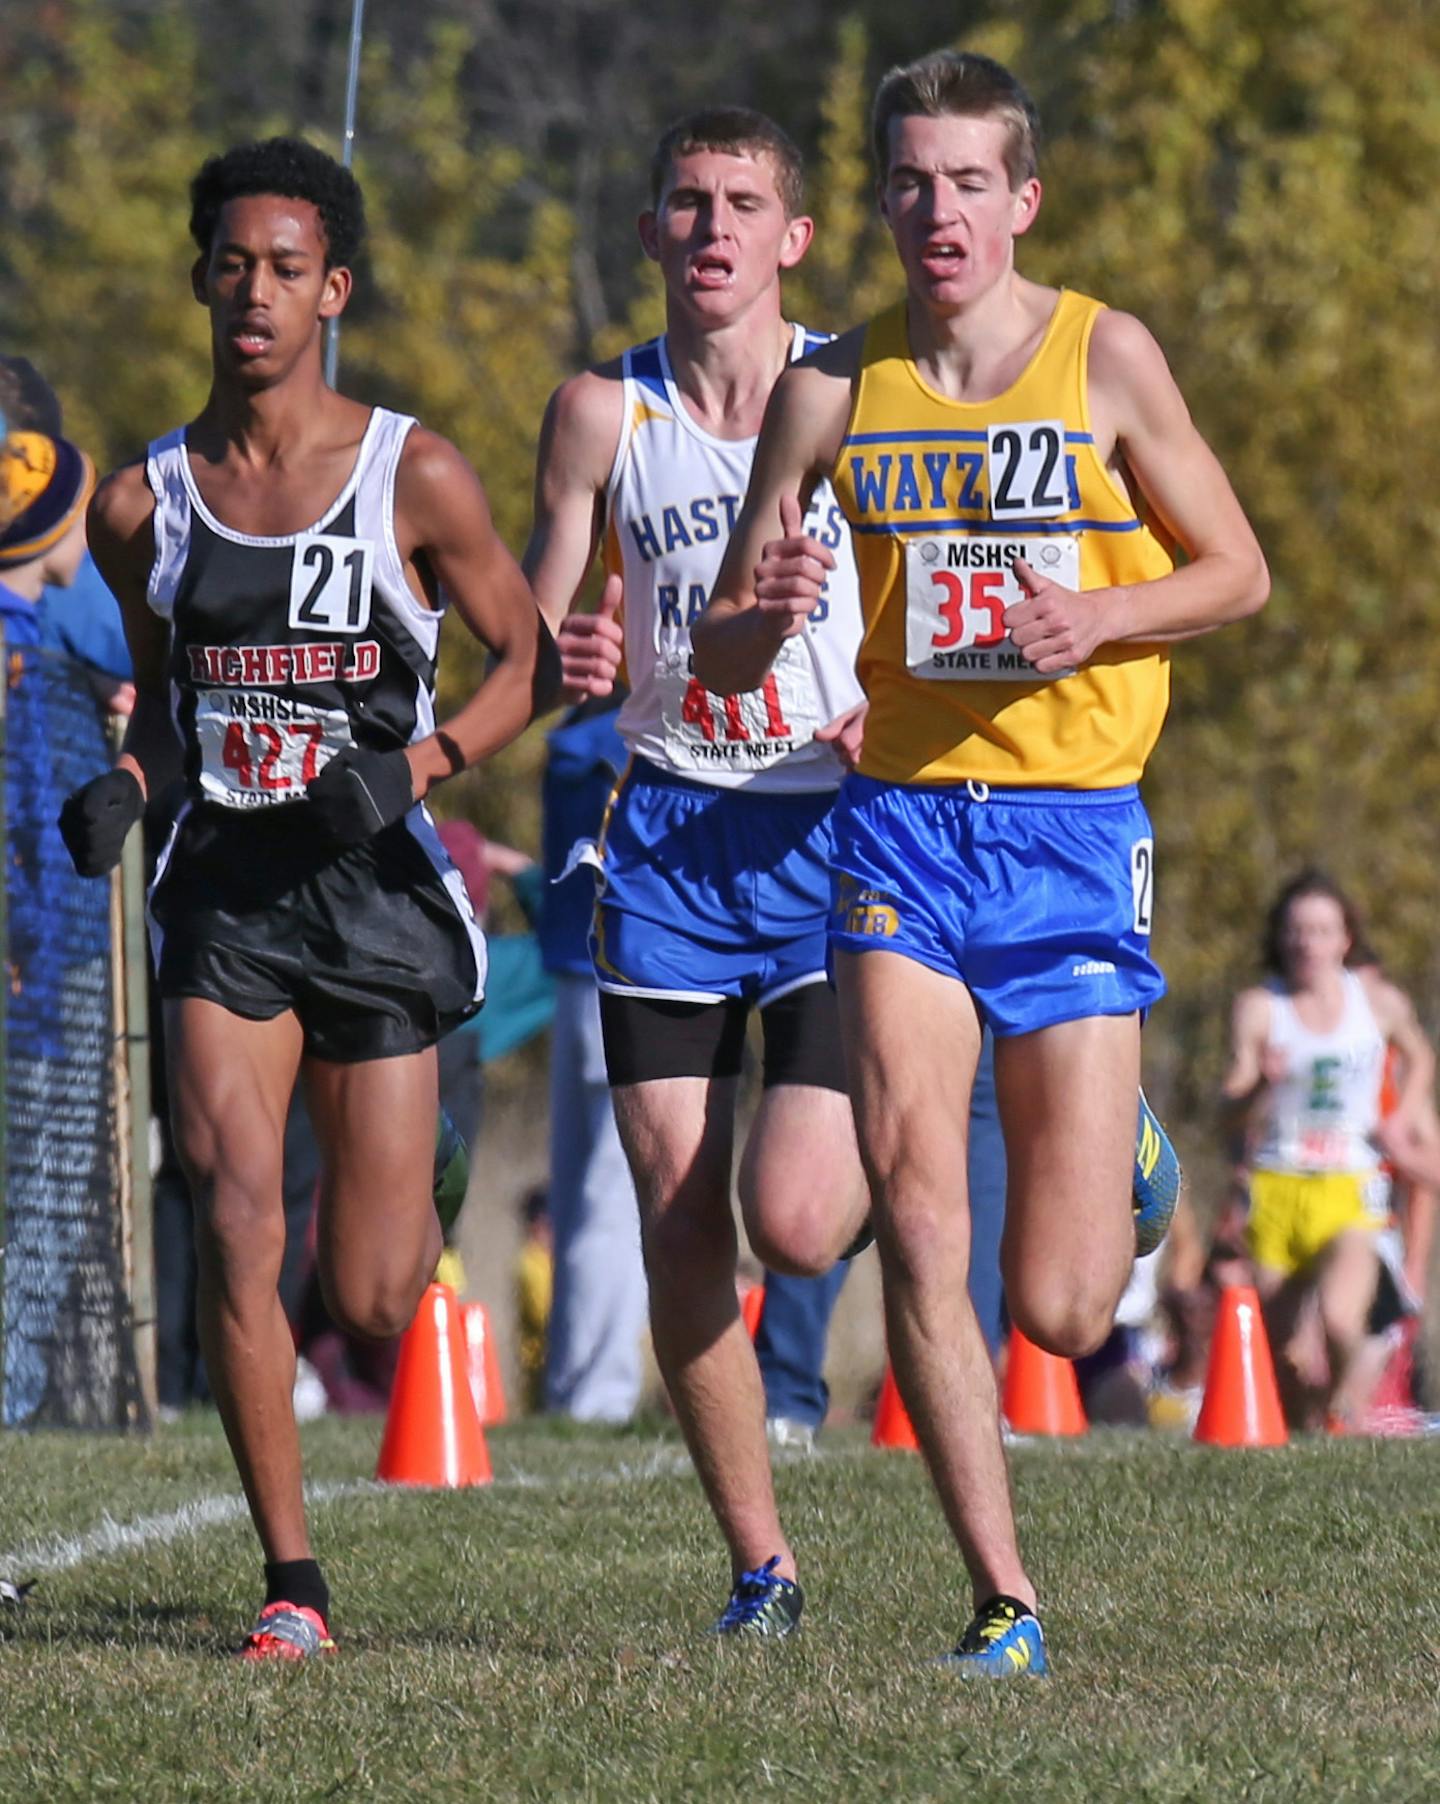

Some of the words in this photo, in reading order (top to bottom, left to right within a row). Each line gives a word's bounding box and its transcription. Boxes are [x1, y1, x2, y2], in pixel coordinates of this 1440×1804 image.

[992, 427, 1064, 510] 22
[629, 495, 842, 562] HASTS
[298, 543, 365, 628] 21
[930, 570, 1036, 648] 35
[186, 640, 381, 685] RICHFIELD
[933, 652, 991, 669] STATE
[682, 673, 792, 741] 411
[222, 722, 325, 789] 427
